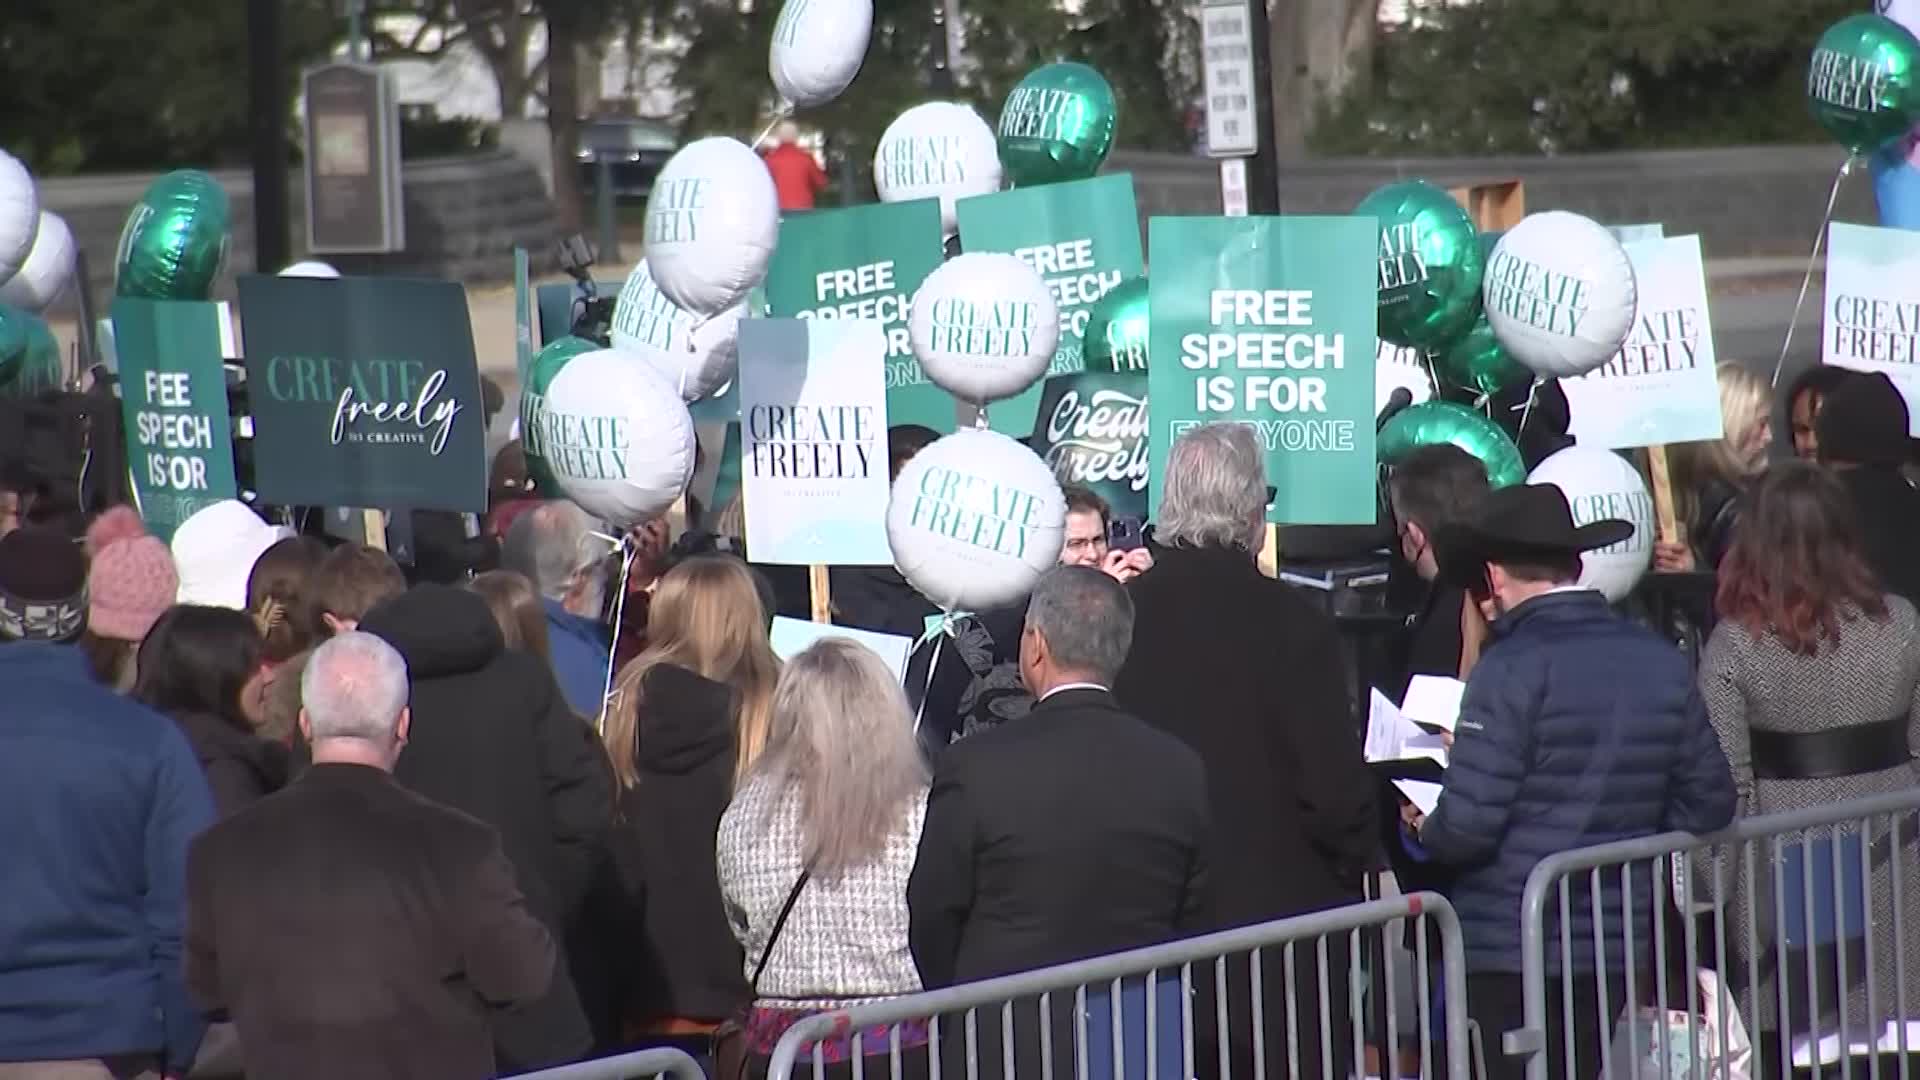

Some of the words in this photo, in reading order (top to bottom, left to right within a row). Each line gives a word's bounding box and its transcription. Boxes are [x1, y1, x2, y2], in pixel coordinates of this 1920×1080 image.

[816, 260, 896, 301] FREE
[1493, 250, 1591, 311] CREATE
[931, 298, 1038, 328] CREATE
[1211, 290, 1312, 325] FREE
[1488, 279, 1585, 337] FREELY
[1834, 294, 1920, 333] CREAT
[931, 325, 1037, 356] FREELY
[1181, 333, 1344, 369] SPEECH
[1834, 326, 1920, 364] FREEL
[266, 355, 424, 401] CREATE
[1196, 376, 1235, 412] IS
[1245, 376, 1327, 412] FOR
[331, 369, 462, 455] freely
[750, 404, 874, 441] CREATE
[752, 442, 873, 479] FREELY
[911, 496, 1038, 559] FREELY
